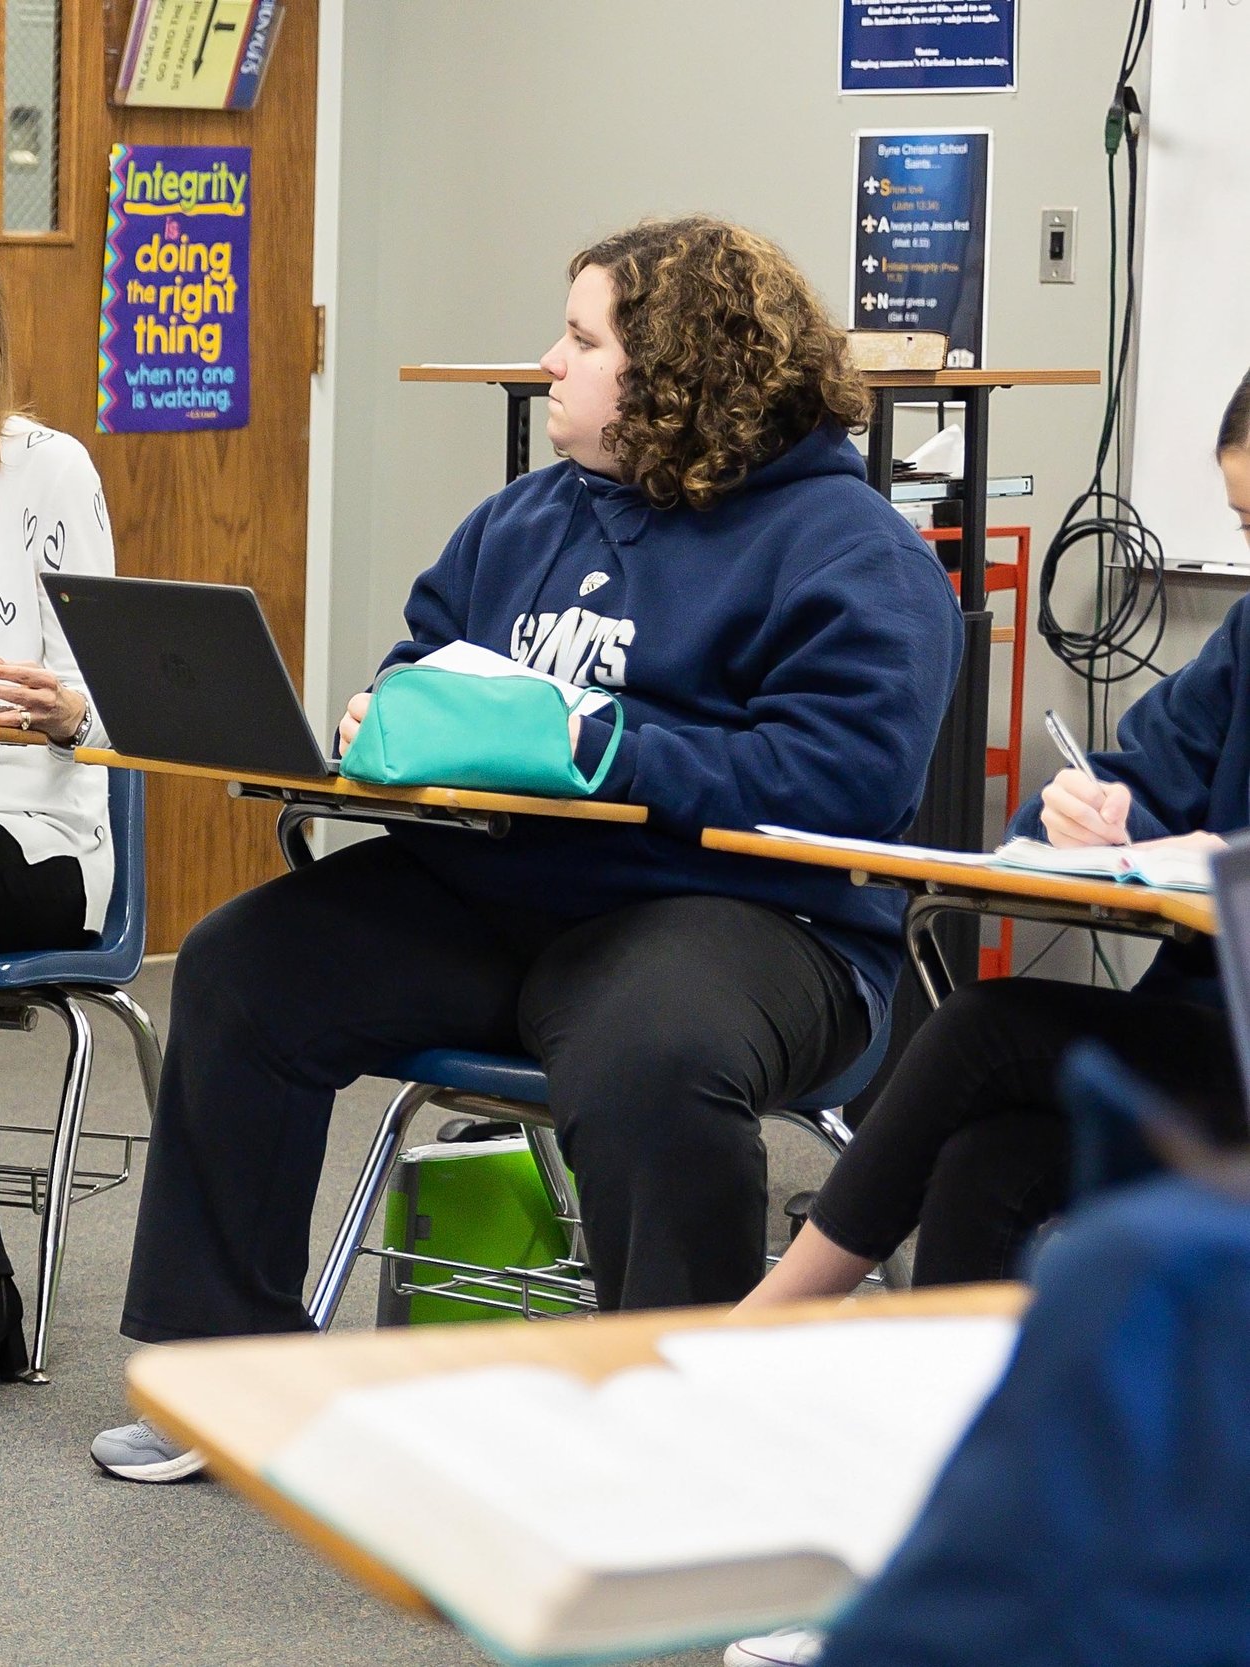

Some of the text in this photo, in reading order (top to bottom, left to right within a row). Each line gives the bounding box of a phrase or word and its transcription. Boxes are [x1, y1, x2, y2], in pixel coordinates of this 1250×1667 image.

[902, 143, 939, 155] Christian
[939, 142, 968, 154] School
[126, 160, 247, 211] Integrity
[165, 216, 180, 240] is
[135, 234, 231, 281] doing
[127, 274, 238, 322] the right
[134, 315, 222, 362] thing
[125, 364, 236, 386] when no one
[132, 387, 146, 409] is
